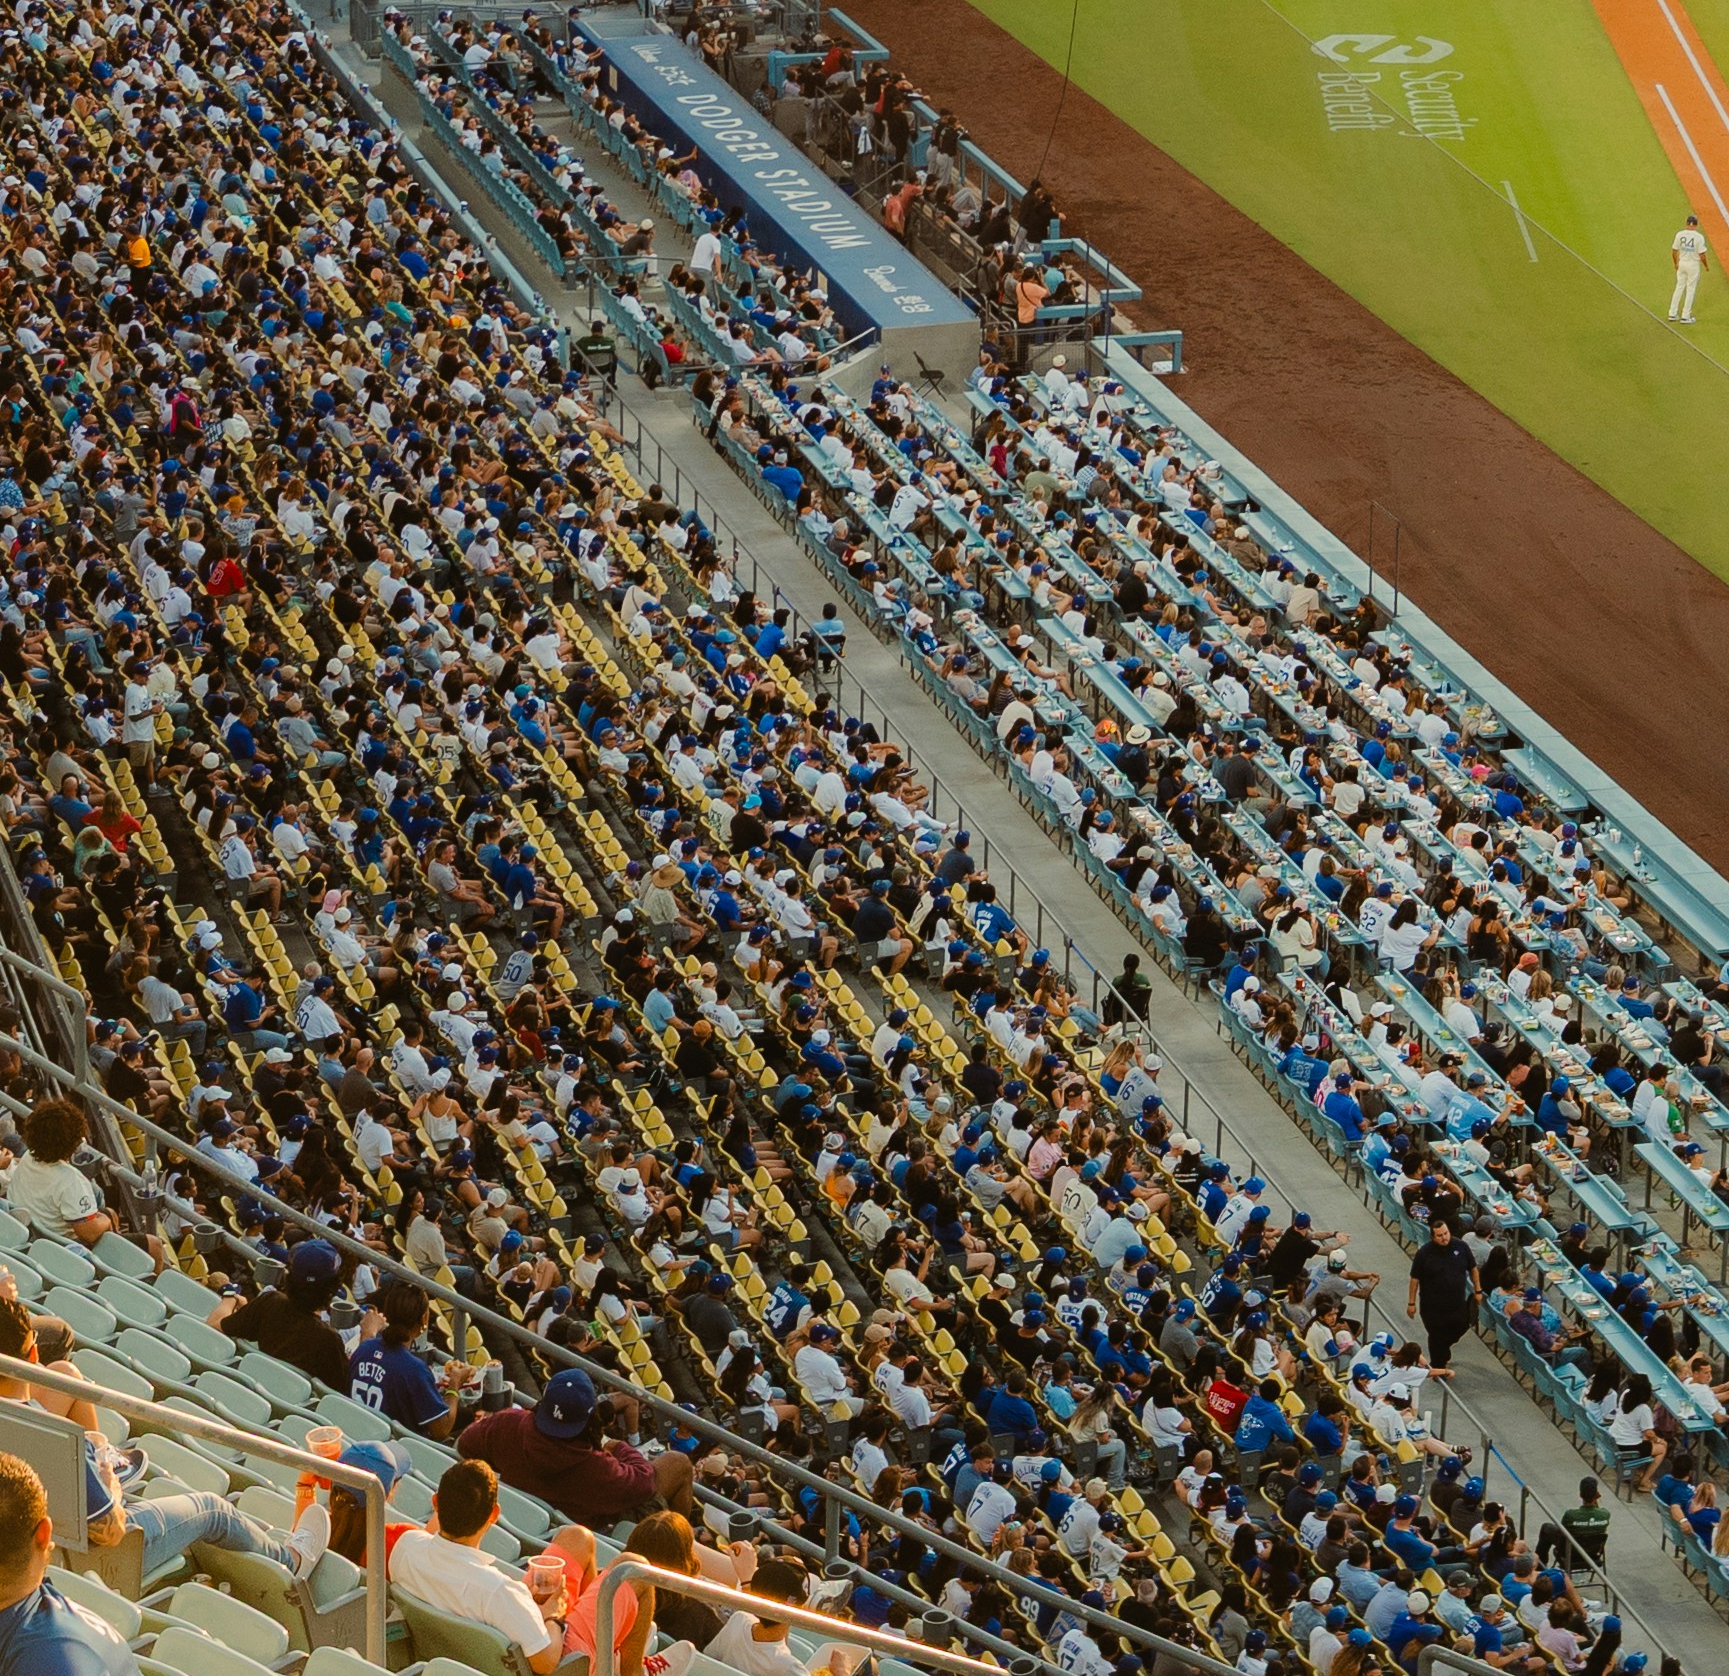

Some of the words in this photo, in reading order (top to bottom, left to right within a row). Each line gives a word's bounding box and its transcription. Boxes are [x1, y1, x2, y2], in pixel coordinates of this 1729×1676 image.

[1317, 72, 1395, 132] Benefit
[1398, 70, 1479, 142] Security
[676, 93, 780, 163] DODGER
[754, 169, 872, 249] STADIUM
[1679, 236, 1695, 248] 84
[895, 495, 904, 508] 5
[1360, 912, 1376, 933] 22
[512, 952, 526, 964] BETTS
[503, 963, 522, 982] 50
[1119, 1082, 1134, 1100] 16
[1448, 1107, 1463, 1127] 42
[1064, 1188, 1081, 1206] 50
[763, 1296, 788, 1329] 24
[358, 1362, 386, 1383] BETTS
[352, 1378, 383, 1411] 50
[1021, 1595, 1040, 1622] 99
